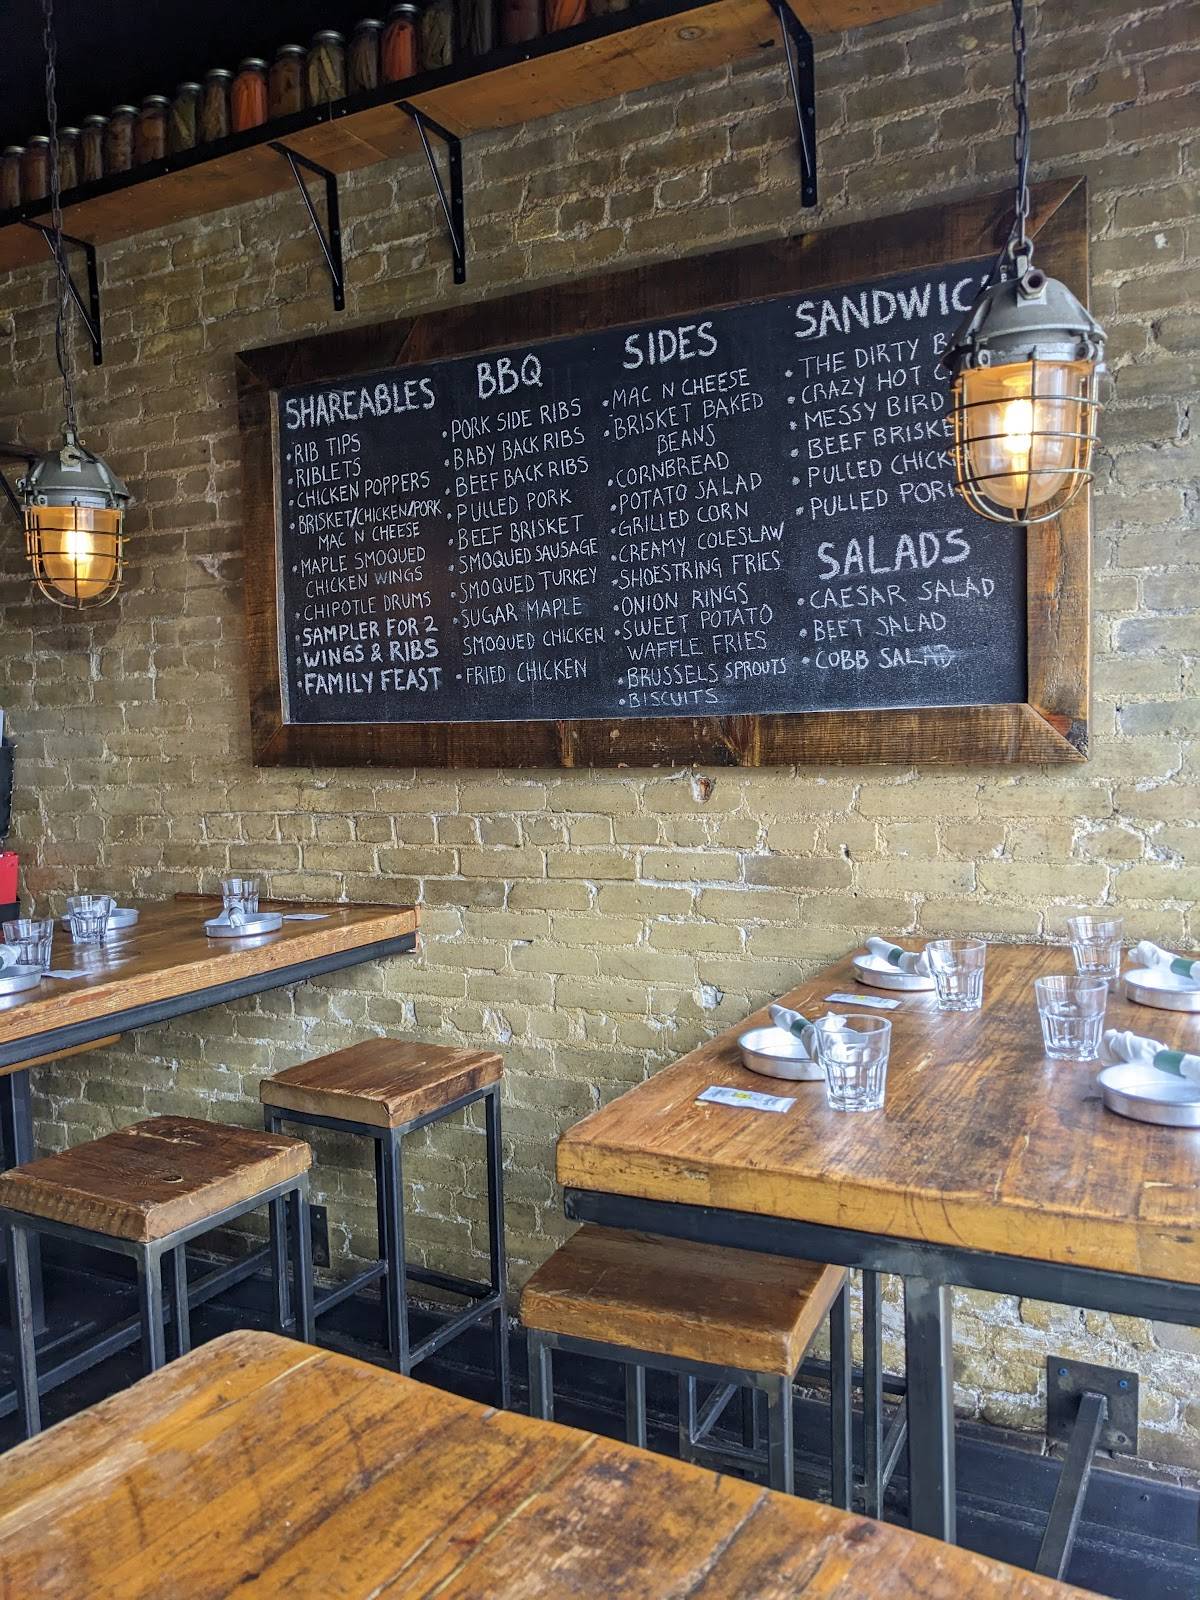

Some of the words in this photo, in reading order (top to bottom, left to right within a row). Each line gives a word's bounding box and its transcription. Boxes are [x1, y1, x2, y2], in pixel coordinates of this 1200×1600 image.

[794, 274, 992, 338] SANDWIC
[623, 321, 718, 370] SIDES
[798, 351, 847, 379] THE
[855, 338, 920, 369] DIRTY
[476, 353, 544, 400] BBQ
[612, 385, 651, 410] MAC
[662, 381, 675, 399] N
[681, 368, 750, 396] CHEESE
[801, 376, 865, 405] CRAZY
[877, 366, 922, 392] HOT
[286, 377, 436, 430] SHAREABLES
[451, 415, 491, 443] PORK
[497, 409, 533, 432] SIDE
[540, 398, 581, 425] RIBS
[614, 402, 692, 440] BRISKET
[703, 392, 764, 419] BAKED
[804, 401, 877, 431] MESSY
[887, 391, 945, 417] BIRD
[293, 441, 319, 465] RIB
[325, 433, 361, 457] TIPS
[453, 443, 496, 471] BABY
[502, 436, 540, 461] BACK
[543, 426, 585, 451] RIBS
[657, 423, 716, 456] BEANS
[808, 431, 867, 460] BEEF
[873, 418, 959, 447] BRISKE
[295, 457, 361, 489] RIBLETS
[455, 471, 499, 498] BEEF
[504, 462, 544, 489] BACK
[548, 456, 589, 478] RIBS
[616, 451, 730, 488] CORNBREAD
[807, 459, 882, 488] PULLED
[297, 480, 360, 508] CHICKEN
[365, 471, 430, 498] POPPERS
[456, 495, 519, 524] PULLED
[527, 488, 572, 511] PORK
[620, 483, 688, 515] POTATO
[694, 472, 763, 500] SALAD
[810, 489, 888, 521] PULLED
[318, 531, 347, 551] MAC
[355, 530, 365, 544] N
[372, 521, 420, 542] CHEESE
[458, 525, 503, 550] BEEF
[510, 514, 584, 543] BRISKET
[618, 509, 690, 537] GRILLED
[697, 501, 749, 523] CORN
[459, 547, 532, 574] SMOQUED
[534, 537, 599, 562] SAUSAGE
[618, 536, 686, 563] CREAMY
[697, 520, 785, 550] COLESLAW
[817, 528, 971, 580] SALADS
[301, 555, 348, 577] MAPLE
[354, 546, 426, 570] SMOQUED
[618, 557, 723, 590] SHOESTRING
[732, 550, 781, 575] FRIES
[306, 573, 368, 598] CHICKEN
[374, 566, 423, 585] WINGS
[459, 574, 535, 604] SMOQUED
[537, 566, 597, 591] TURKEY
[621, 591, 678, 617] ONION
[692, 582, 749, 610] RINGS
[809, 584, 907, 610] CAESAR
[917, 576, 995, 604] SALAD
[304, 596, 377, 621] CHIPOTLE
[383, 591, 432, 612] DRUMS
[460, 602, 518, 629] SUGAR
[526, 597, 583, 622] MAPLE
[622, 614, 690, 640] SWEET
[700, 603, 773, 630] POTATO
[302, 620, 380, 647] SAMPLER
[386, 617, 419, 637] FOR
[424, 615, 439, 633] 2
[463, 632, 536, 656] SMOQUED
[543, 627, 606, 647] CHICKEN
[813, 618, 863, 642] BEET
[875, 611, 946, 637] SALAD
[303, 644, 365, 668] WINGS
[371, 642, 384, 663] &
[389, 638, 439, 663] RIBS
[626, 637, 704, 661] WAFFLE
[713, 630, 767, 654] FRIES
[815, 650, 870, 670] COBB
[304, 671, 373, 696] FAMILY
[380, 666, 443, 692] FEAST
[466, 665, 506, 685] FRIED
[517, 657, 587, 683] CHICKEN
[627, 663, 719, 689] BRUSSELS
[725, 657, 787, 681] SPROUTS
[629, 688, 719, 709] BISCUITS
